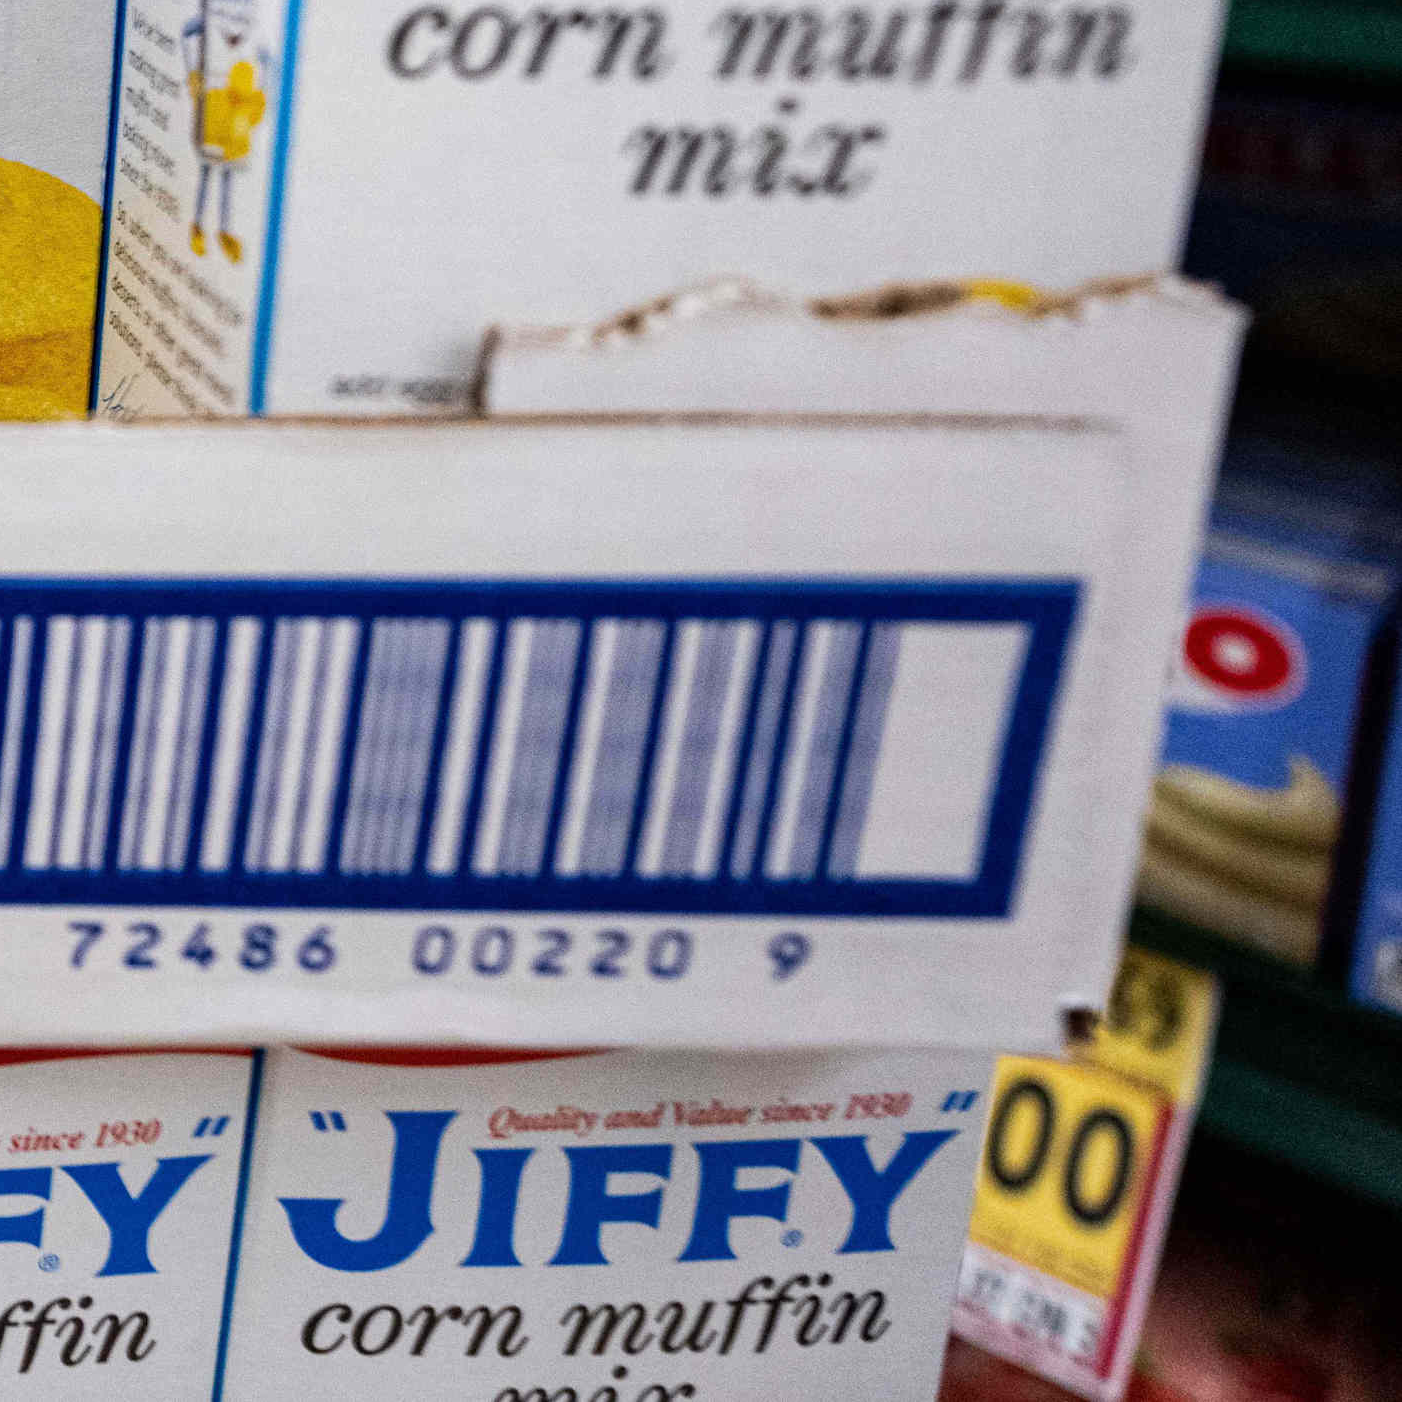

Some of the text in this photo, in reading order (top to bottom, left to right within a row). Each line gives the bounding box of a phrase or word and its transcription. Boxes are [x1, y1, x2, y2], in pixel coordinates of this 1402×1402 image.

[383, 1, 676, 82] corn
[622, 97, 889, 200] mix
[65, 919, 341, 975] 72486
[410, 925, 697, 981] 00220
[765, 932, 812, 982] 9
[7, 1127, 84, 1154] since
[94, 1118, 164, 1149] 1930
[299, 1299, 531, 1359] corn
[558, 1271, 892, 1359] muffin
